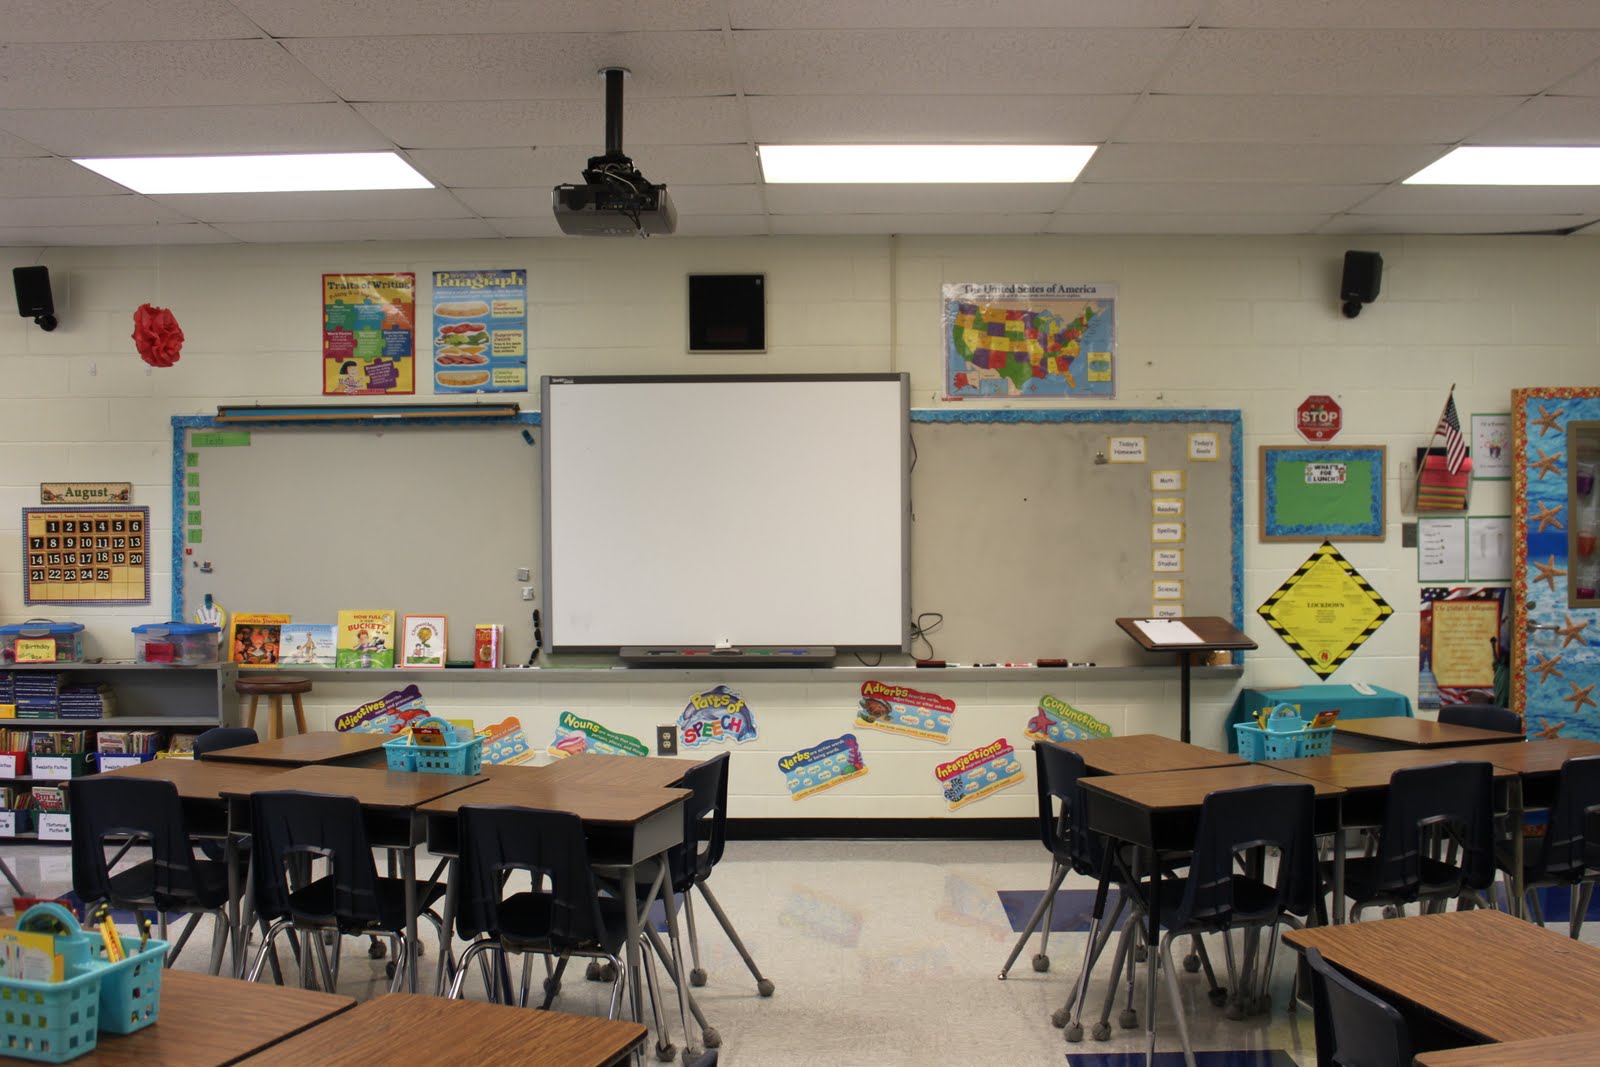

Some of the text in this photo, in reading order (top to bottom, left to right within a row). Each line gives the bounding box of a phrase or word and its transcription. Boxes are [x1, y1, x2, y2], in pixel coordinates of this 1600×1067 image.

[328, 281, 411, 291] Traits of Writing
[436, 271, 524, 290] Paragraph
[983, 285, 1015, 294] United
[1017, 285, 1046, 294] States
[1047, 285, 1057, 293] of
[1057, 285, 1097, 294] America
[1301, 411, 1338, 423] STOP
[1193, 440, 1214, 448] Today's
[1114, 448, 1142, 456] Homework
[64, 486, 108, 501] August
[1157, 506, 1179, 515] Reading
[67, 523, 73, 531] 2
[83, 523, 89, 531] 3
[98, 522, 105, 530] 4
[115, 522, 122, 530] 5
[132, 522, 139, 530] 6
[1156, 528, 1178, 536] Spelling
[34, 538, 141, 547] 7 8 9 10 11 12 13
[31, 552, 142, 565] 14 15 16 17 18 19 20
[32, 570, 109, 580] 21 22 23 24 25
[347, 622, 386, 632] BUCKET?
[25, 643, 50, 652] Birthday
[863, 683, 909, 698] Adverbs
[691, 692, 745, 714] Parts of
[337, 700, 386, 730] Adjectives
[1043, 696, 1109, 734] Conjunctions
[563, 713, 601, 733] Nouns
[684, 714, 743, 744] SPEECH
[780, 751, 811, 770] Verbs
[936, 741, 1002, 778] Interjections
